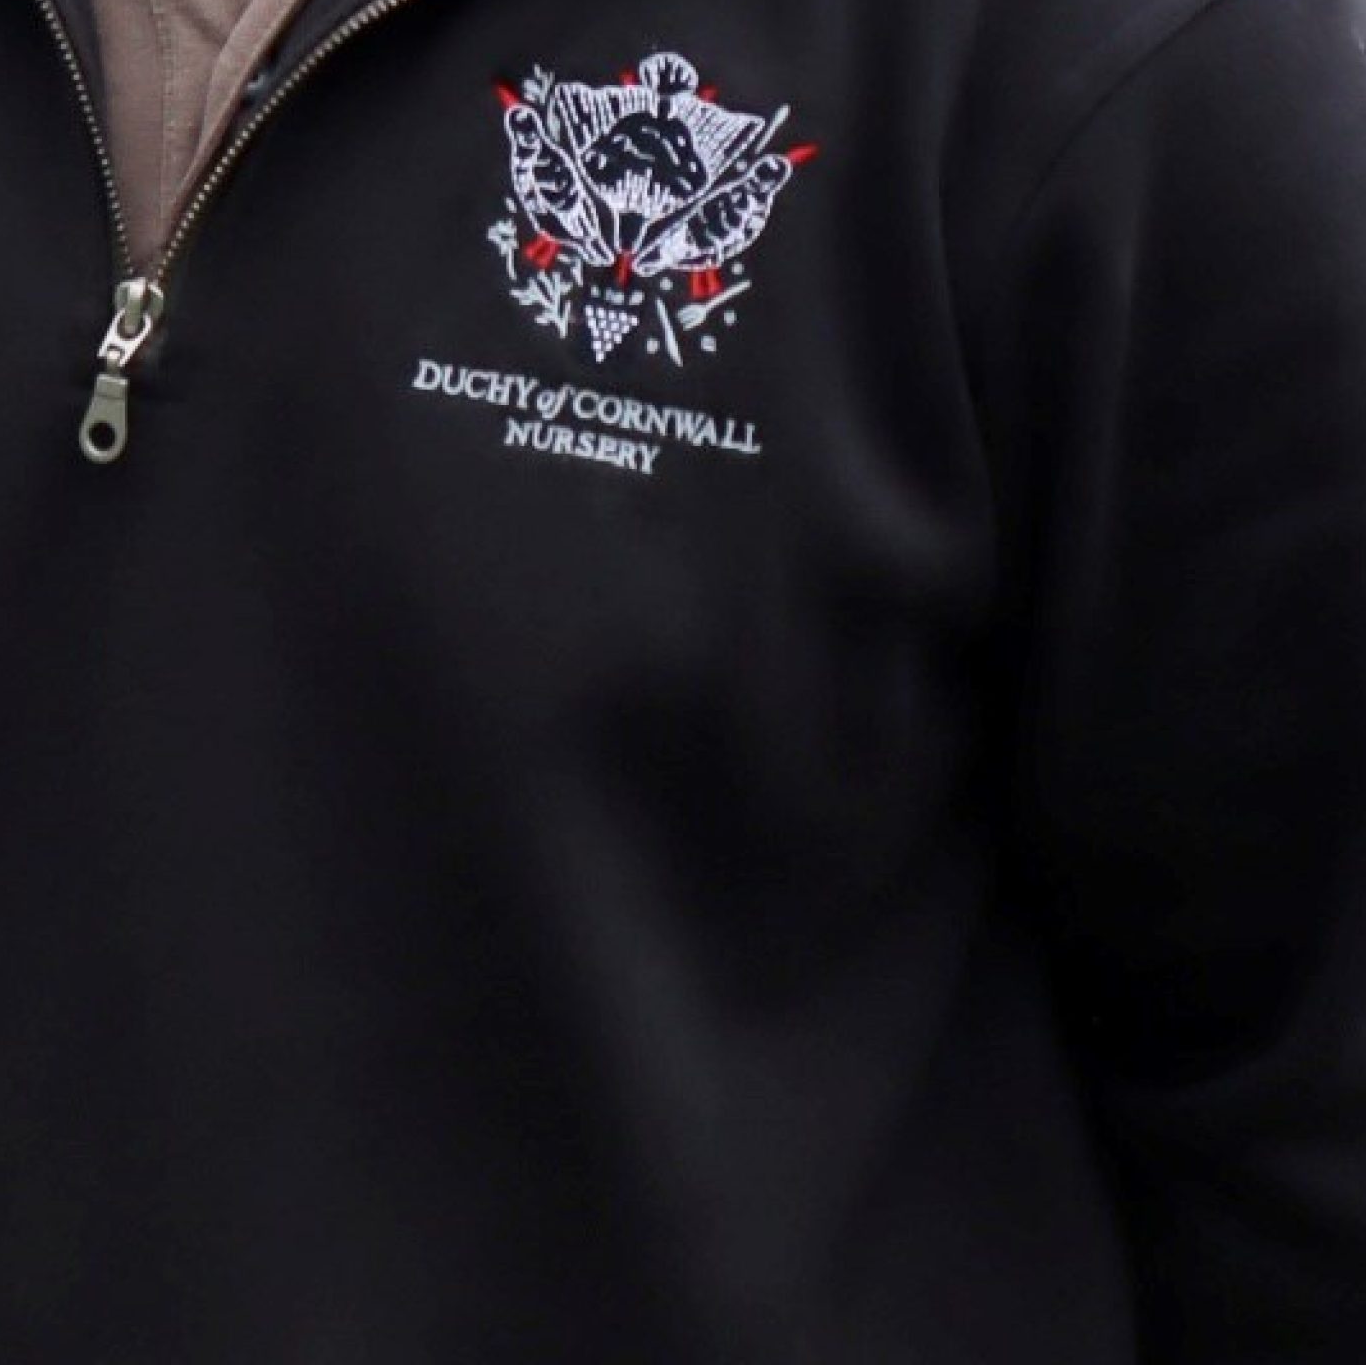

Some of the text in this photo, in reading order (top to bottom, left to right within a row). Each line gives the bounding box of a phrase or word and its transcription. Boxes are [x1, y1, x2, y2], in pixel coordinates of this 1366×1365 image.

[412, 358, 763, 455] DUCHY of CORNWALL
[503, 416, 661, 475] NURSERY
